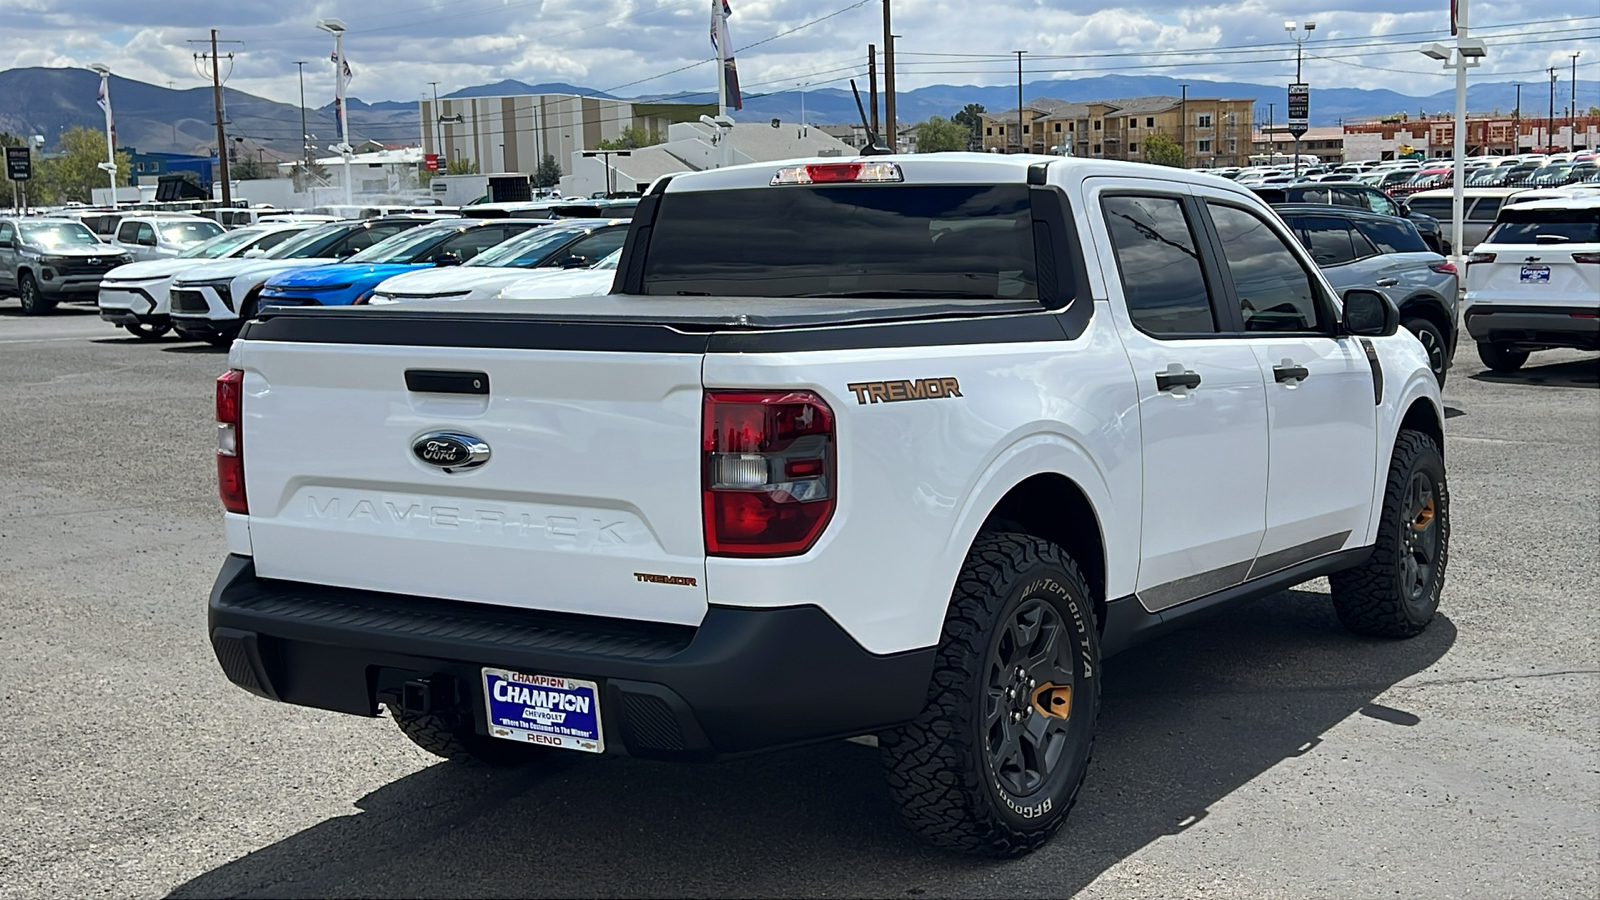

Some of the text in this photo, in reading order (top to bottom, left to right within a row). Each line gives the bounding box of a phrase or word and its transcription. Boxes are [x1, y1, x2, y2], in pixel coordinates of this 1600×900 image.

[847, 377, 963, 405] TREMOR
[423, 440, 457, 461] Ford
[305, 495, 627, 550] MAVERICK
[634, 572, 697, 587] TREMOR
[1020, 578, 1093, 678] All-Terrain T/A
[512, 672, 565, 688] CHAMPION
[493, 680, 590, 714] CHAMPION
[524, 709, 563, 721] CHEVROLET
[520, 720, 529, 729] The
[530, 722, 554, 733] Customer
[560, 727, 570, 735] The
[527, 733, 562, 746] RENO
